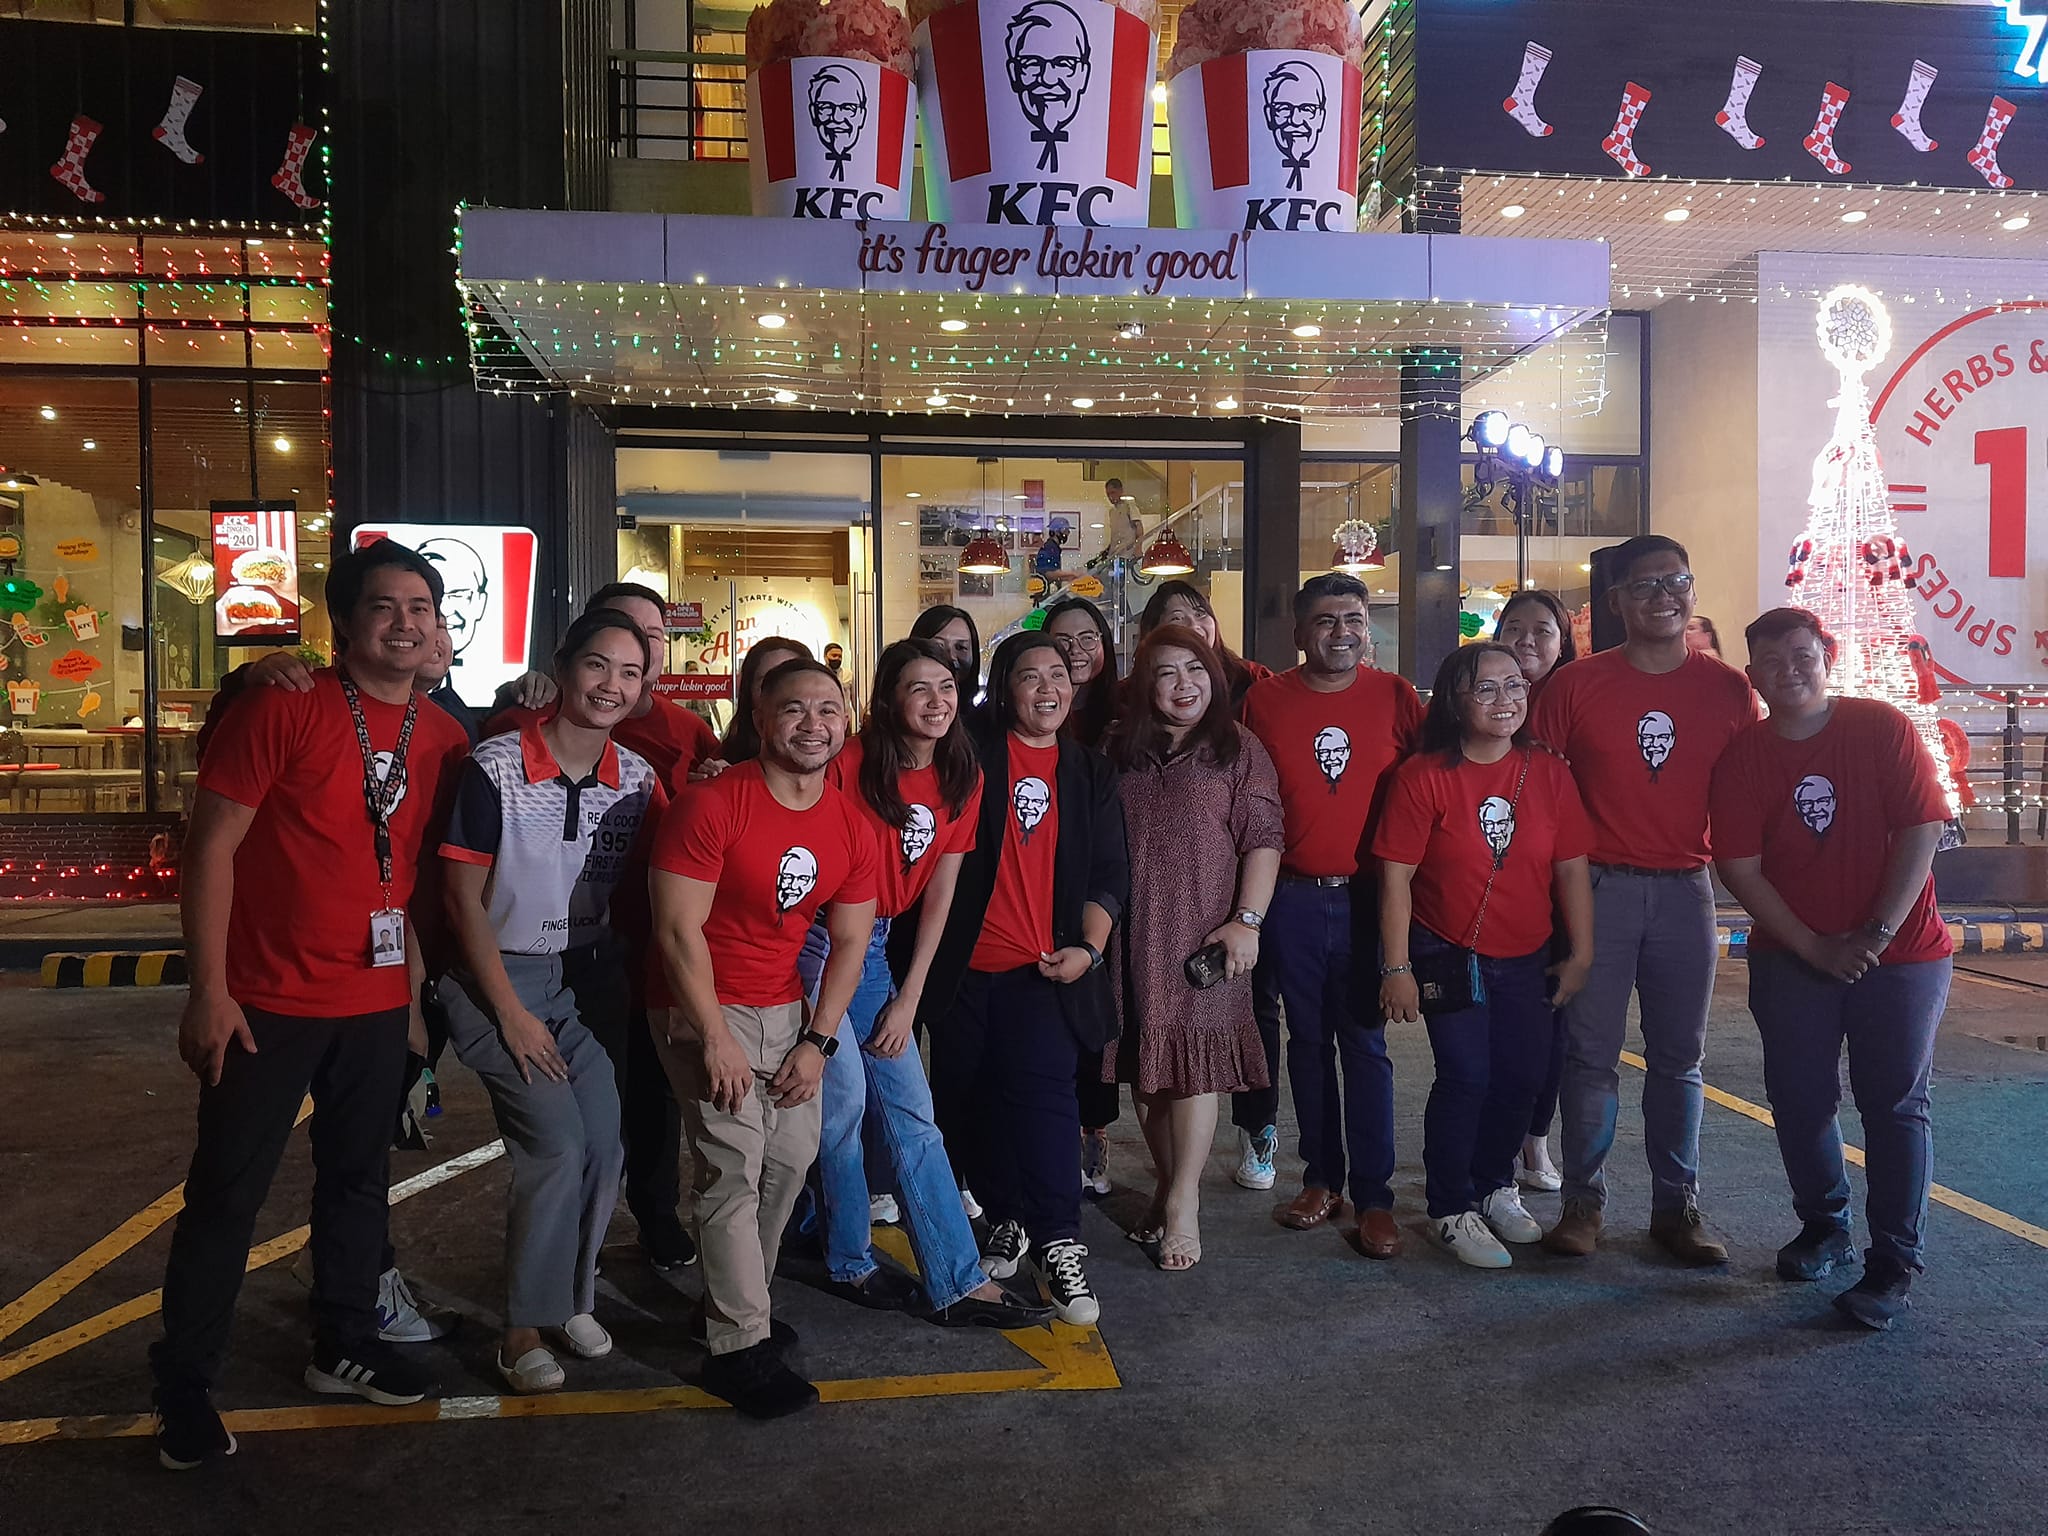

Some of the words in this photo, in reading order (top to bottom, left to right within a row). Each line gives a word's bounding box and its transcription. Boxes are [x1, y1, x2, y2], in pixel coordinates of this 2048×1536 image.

[793, 187, 883, 220] KFC
[986, 182, 1114, 227] KFC
[1245, 198, 1341, 231] KFC
[915, 223, 1030, 291] finger
[1037, 225, 1140, 278] lickin'
[1904, 344, 2014, 447] HERBS
[738, 594, 773, 603] STARTS
[1906, 553, 2017, 656] SPICES
[587, 829, 636, 853] 195
[541, 918, 570, 932] FINGE
